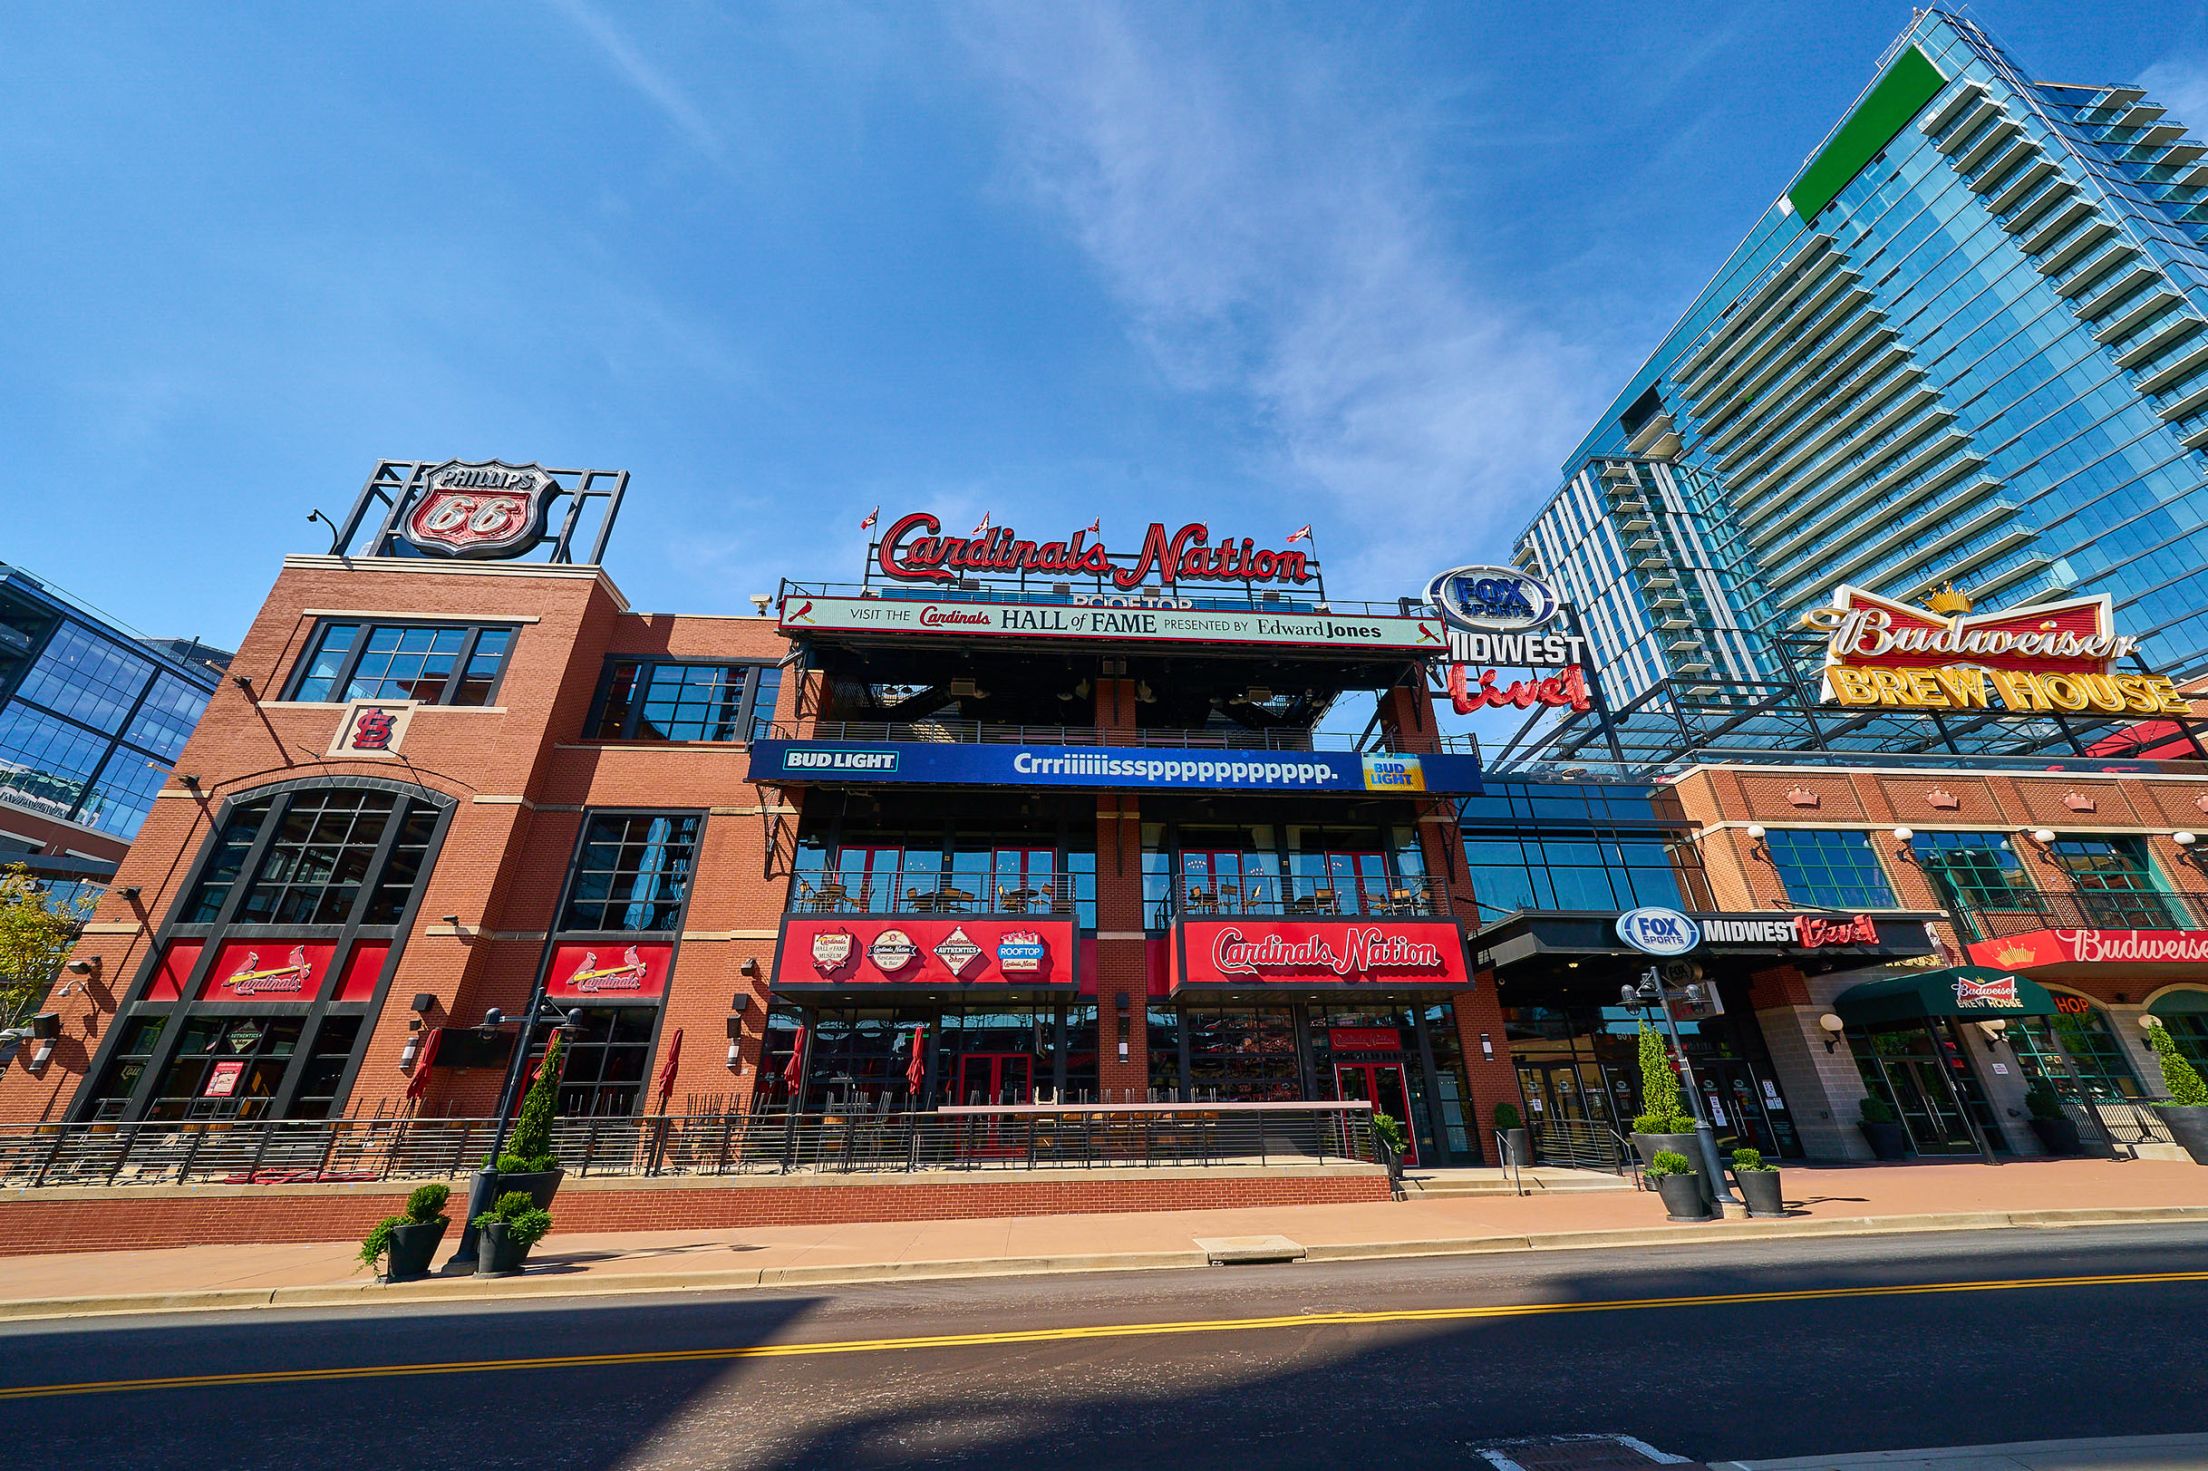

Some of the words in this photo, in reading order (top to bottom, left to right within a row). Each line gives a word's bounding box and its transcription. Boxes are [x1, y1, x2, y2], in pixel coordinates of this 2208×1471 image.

[440, 470, 535, 489] PHILLIPS
[425, 495, 518, 534] 66
[878, 512, 1117, 583] Cardinals
[1112, 522, 1313, 591] Nation
[1453, 577, 1530, 604] FOX
[1461, 603, 1535, 617] SPORTS
[850, 608, 880, 620] VISIT
[886, 609, 911, 621] THE
[919, 605, 991, 627] Cardinals
[1001, 609, 1068, 632] HALL
[1071, 613, 1088, 630] of
[1091, 612, 1157, 634] FAME
[1165, 619, 1230, 631] PRESENTED
[1234, 621, 1249, 632] BY
[1802, 607, 2141, 659] Budweiser
[1448, 663, 1590, 715] Live!
[1825, 665, 1989, 710] BREW
[1990, 668, 2191, 717] HOUSE
[787, 753, 831, 767] BUD
[833, 754, 895, 769] LIGHT
[1373, 762, 1405, 773] BUD
[1370, 773, 1412, 785] LIGHT
[1637, 917, 1681, 935] FOX
[1703, 920, 1799, 942] MIDWEST
[1643, 936, 1685, 945] SPORTS
[938, 946, 977, 954] AUTHENTICS
[1000, 947, 1040, 956] ROOFTOP
[1212, 927, 1337, 974] Cardinals
[1332, 927, 1441, 974] Nation
[1951, 983, 2018, 997] Budweiser
[1956, 999, 1985, 1008] BREW
[1987, 998, 2024, 1008] HOUSE
